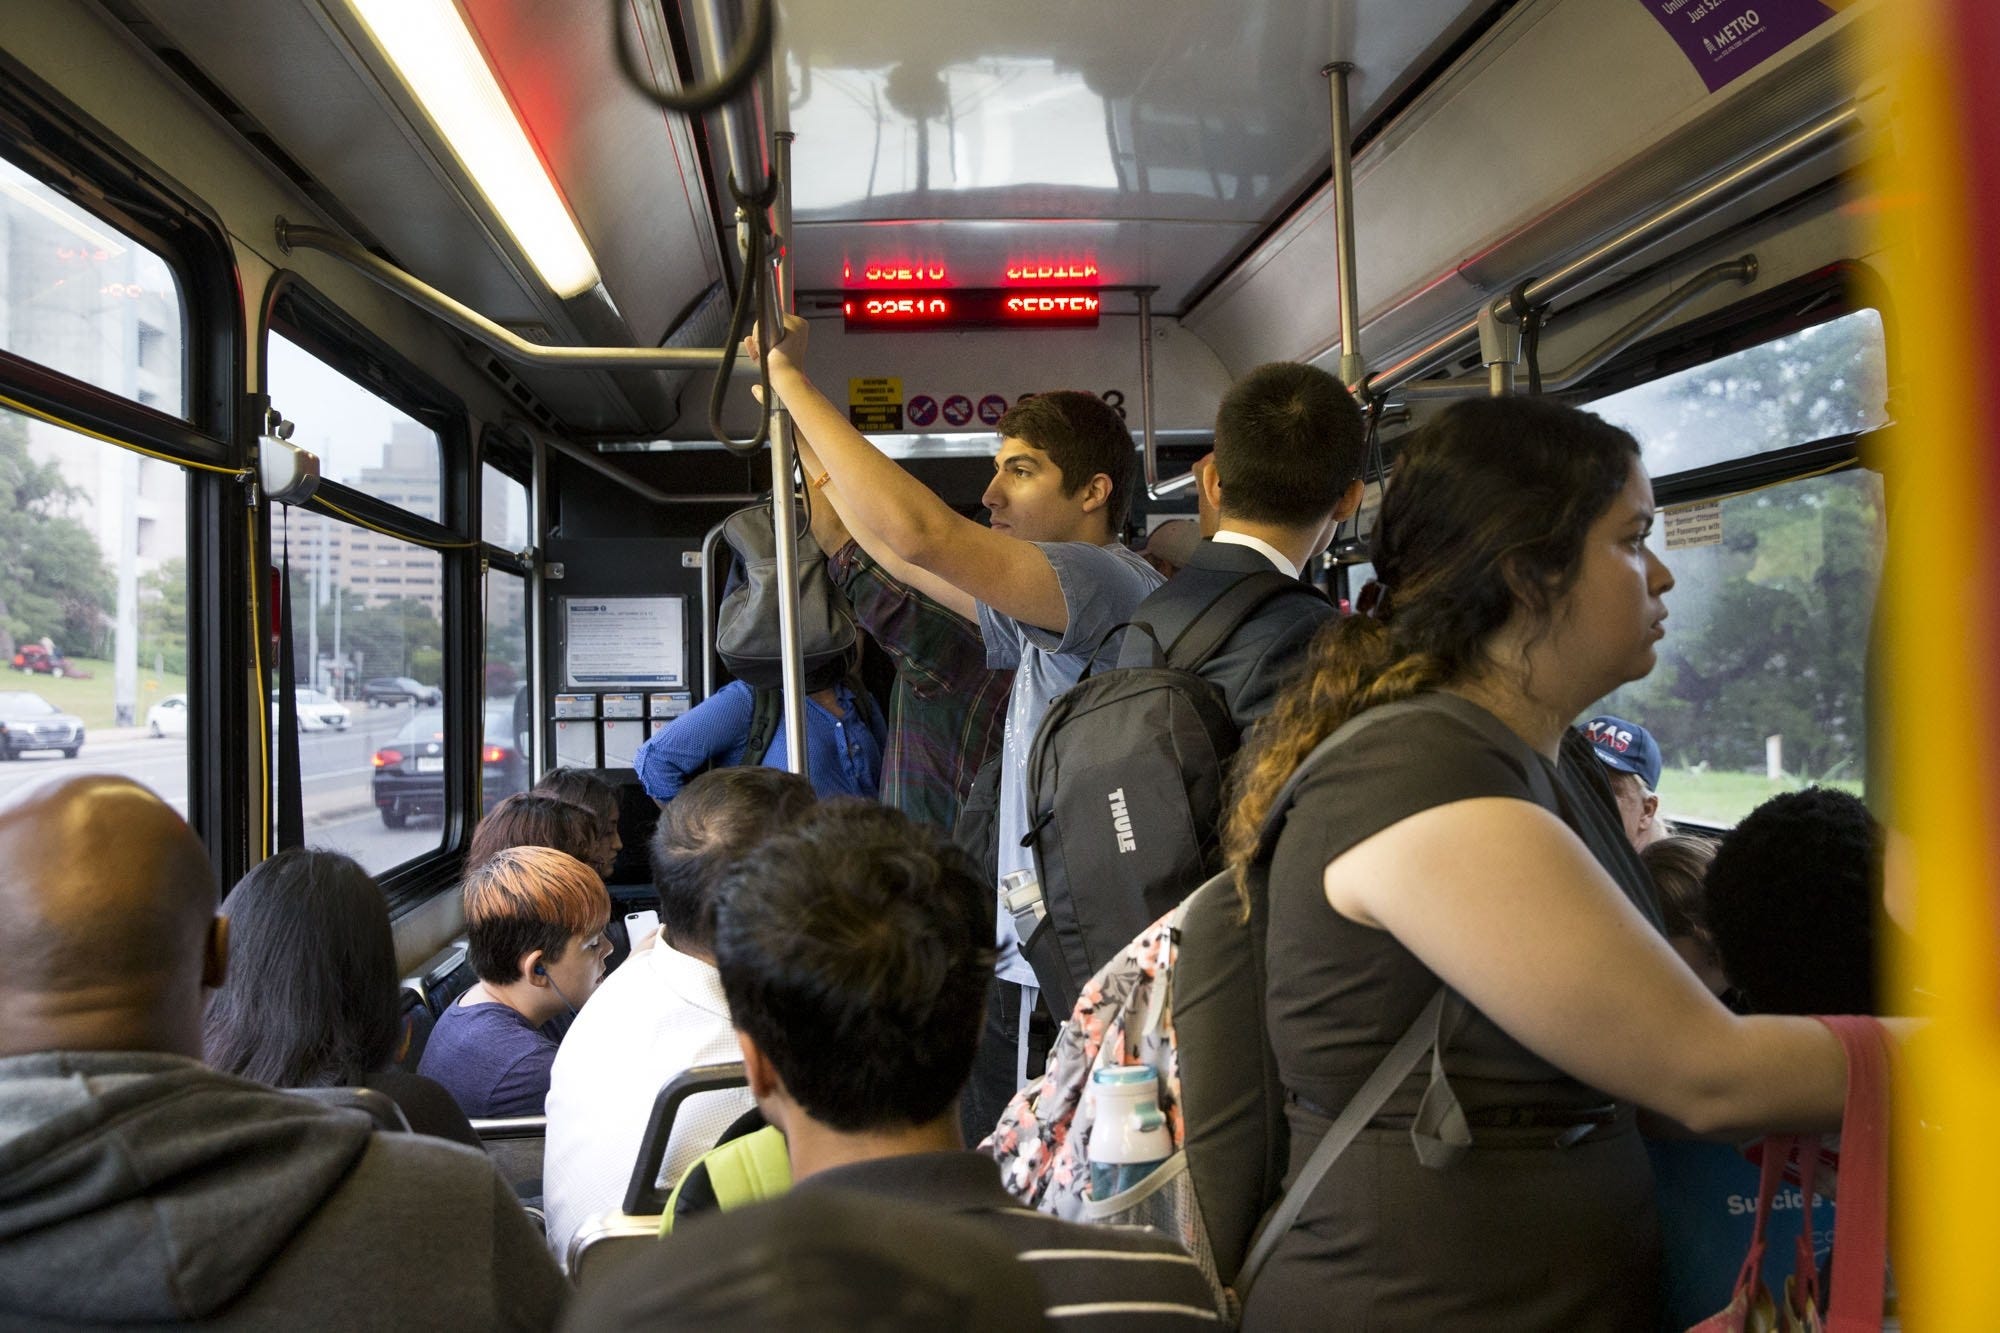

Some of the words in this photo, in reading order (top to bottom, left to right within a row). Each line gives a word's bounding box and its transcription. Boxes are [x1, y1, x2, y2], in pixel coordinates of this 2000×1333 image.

[1687, 4, 1708, 23] Just
[1713, 9, 1760, 49] METRO
[1107, 787, 1137, 854] THULE
[1726, 1189, 1822, 1216] Sucide
